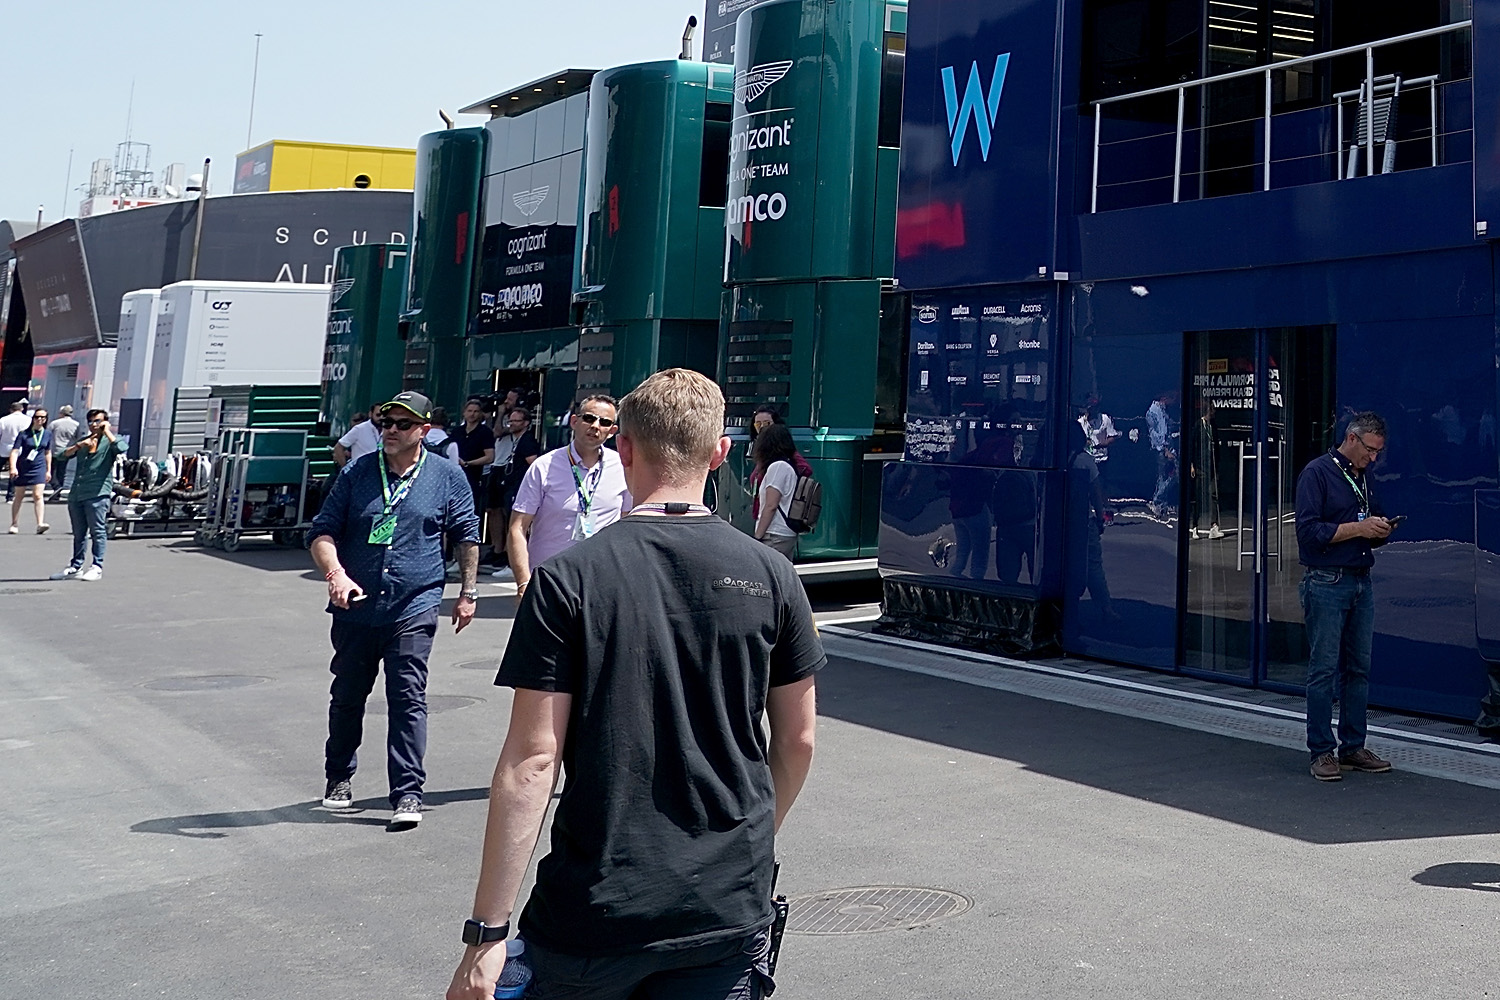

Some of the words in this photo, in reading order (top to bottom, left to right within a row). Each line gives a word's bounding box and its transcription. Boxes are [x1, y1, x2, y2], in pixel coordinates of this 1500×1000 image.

[730, 119, 791, 162] gnizant
[761, 163, 788, 177] TEAM
[726, 192, 787, 224] amco
